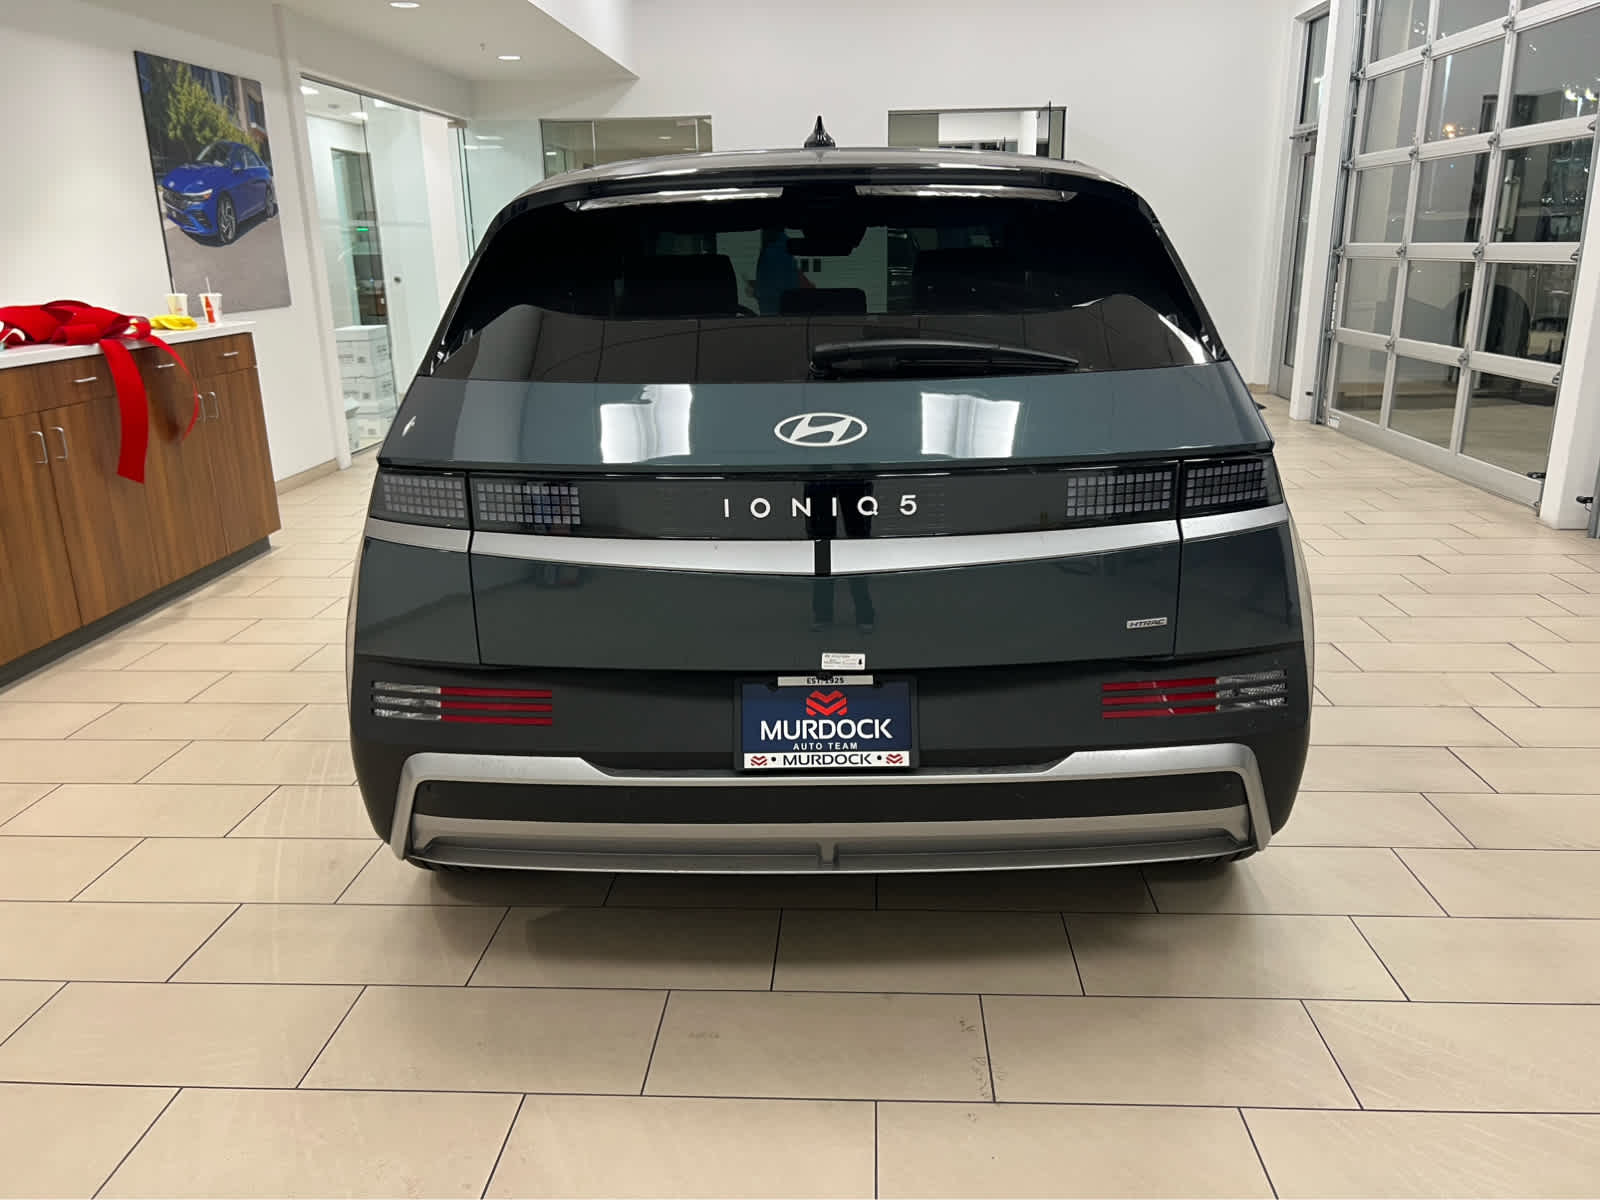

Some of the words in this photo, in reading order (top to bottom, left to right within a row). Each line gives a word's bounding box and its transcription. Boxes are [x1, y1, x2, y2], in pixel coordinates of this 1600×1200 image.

[760, 719, 893, 741] MURDOCK
[793, 742, 823, 751] AUTO
[828, 742, 858, 750] TEAM
[783, 753, 872, 766] MURDOCK
